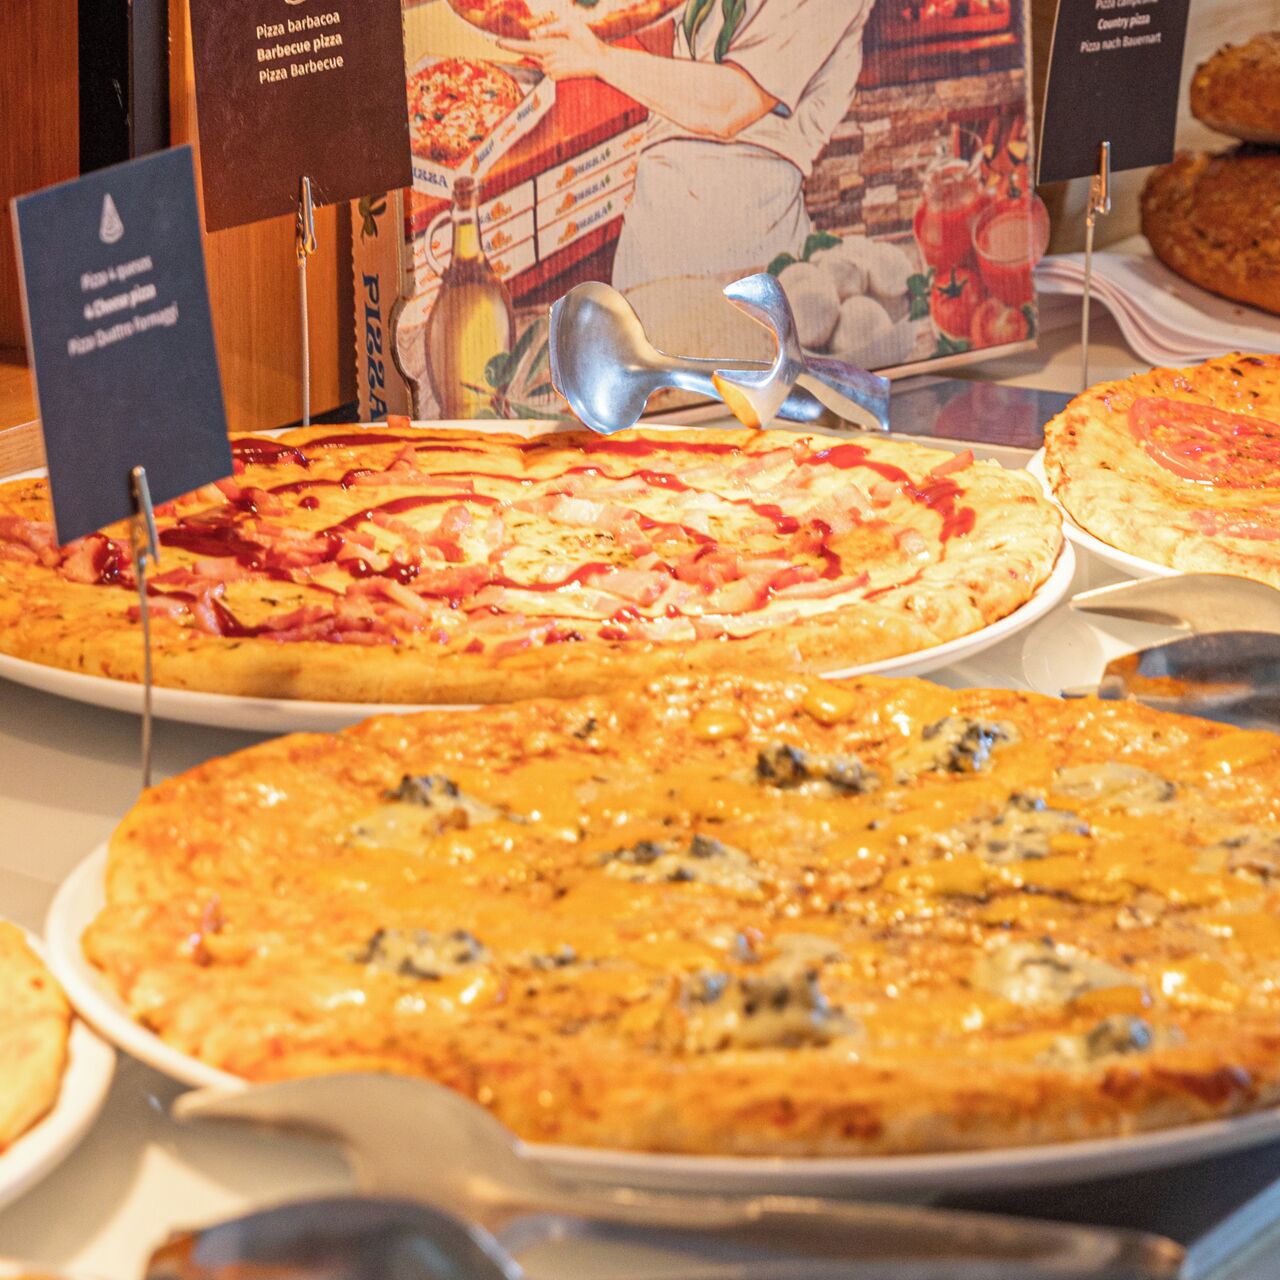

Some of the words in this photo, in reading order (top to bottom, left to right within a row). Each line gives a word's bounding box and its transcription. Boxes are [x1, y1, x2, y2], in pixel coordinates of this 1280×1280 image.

[256, 23, 285, 40] Pizza
[287, 11, 340, 33] barbacoa
[1097, 17, 1129, 30] Country
[1129, 13, 1151, 29] pizza
[257, 40, 311, 62] Barbecue
[313, 33, 343, 53] pizza
[1080, 40, 1101, 53] Pizza
[1102, 37, 1121, 49] nach
[259, 67, 288, 84] Pizza
[290, 55, 344, 78] Barbecue
[412, 166, 449, 188] IZZA
[362, 272, 388, 421] PIZZA
